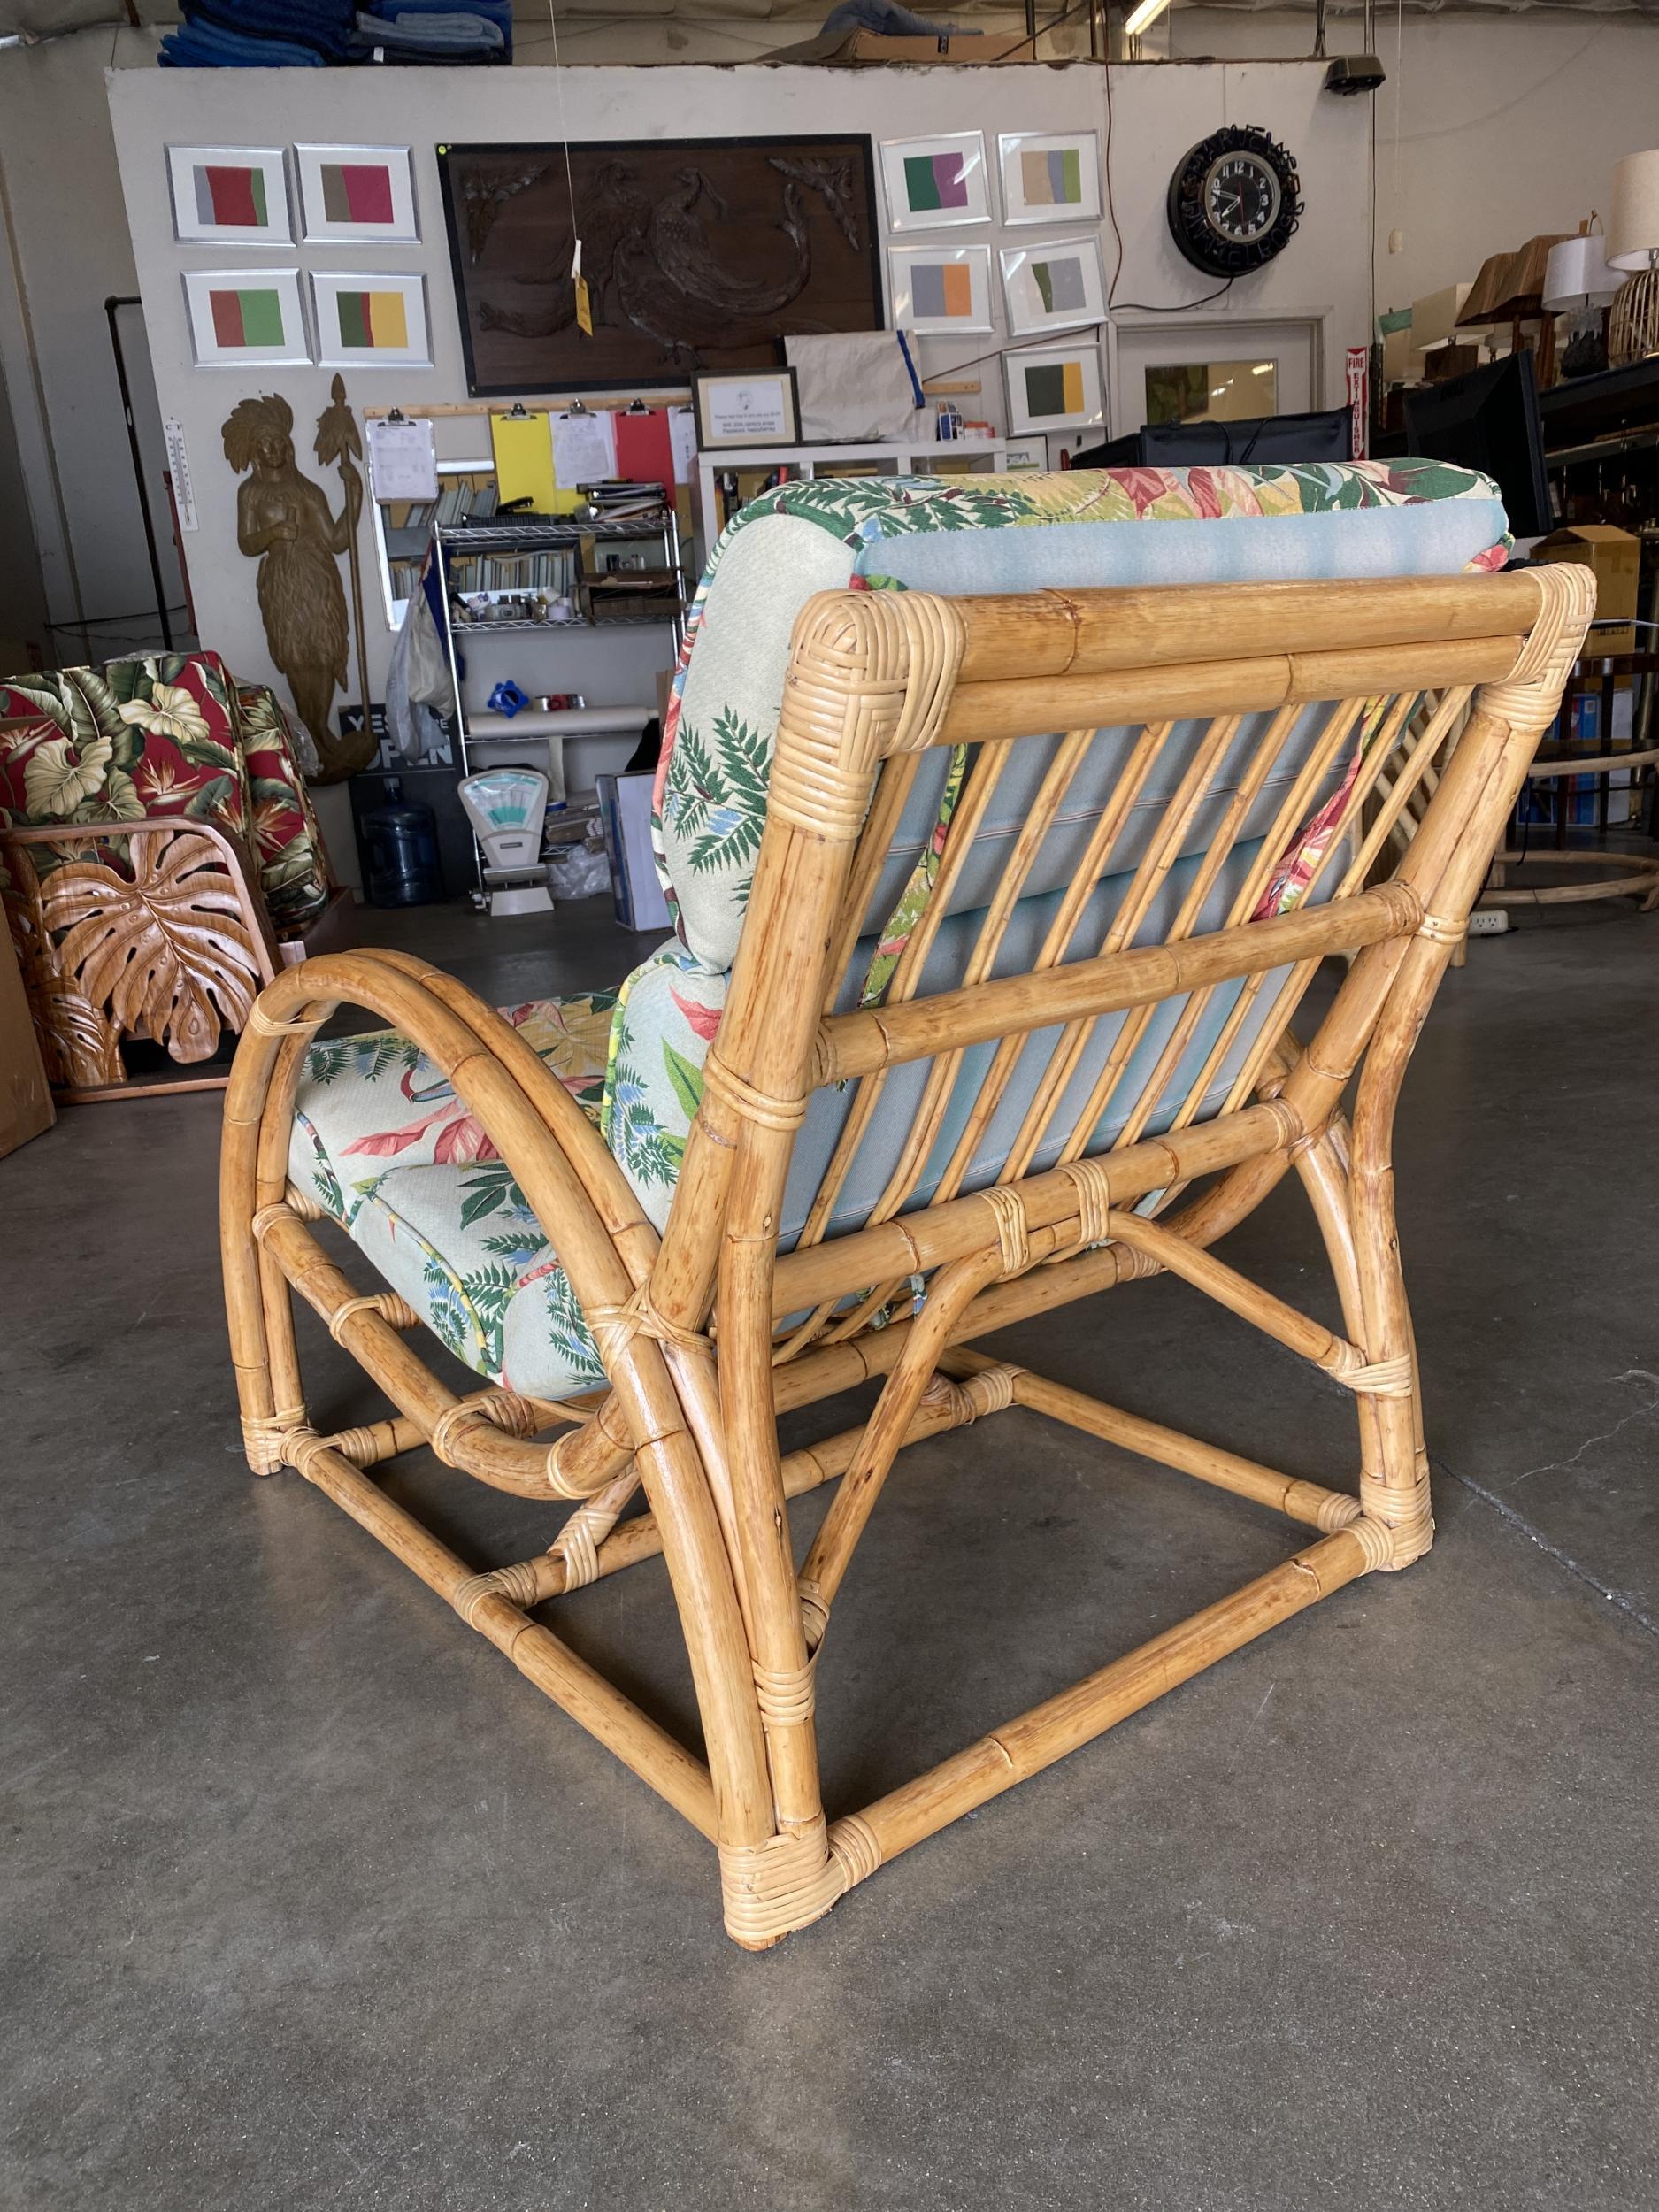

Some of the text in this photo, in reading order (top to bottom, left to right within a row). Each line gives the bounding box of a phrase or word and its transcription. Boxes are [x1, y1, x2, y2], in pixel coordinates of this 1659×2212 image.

[1222, 165, 1230, 179] 11
[1234, 161, 1244, 173] 12
[1248, 165, 1254, 178] 1
[1259, 178, 1266, 189] 2
[1261, 195, 1269, 206] 3
[1256, 211, 1265, 222] 4
[1248, 224, 1256, 234] 5
[1348, 357, 1364, 369] FIRE
